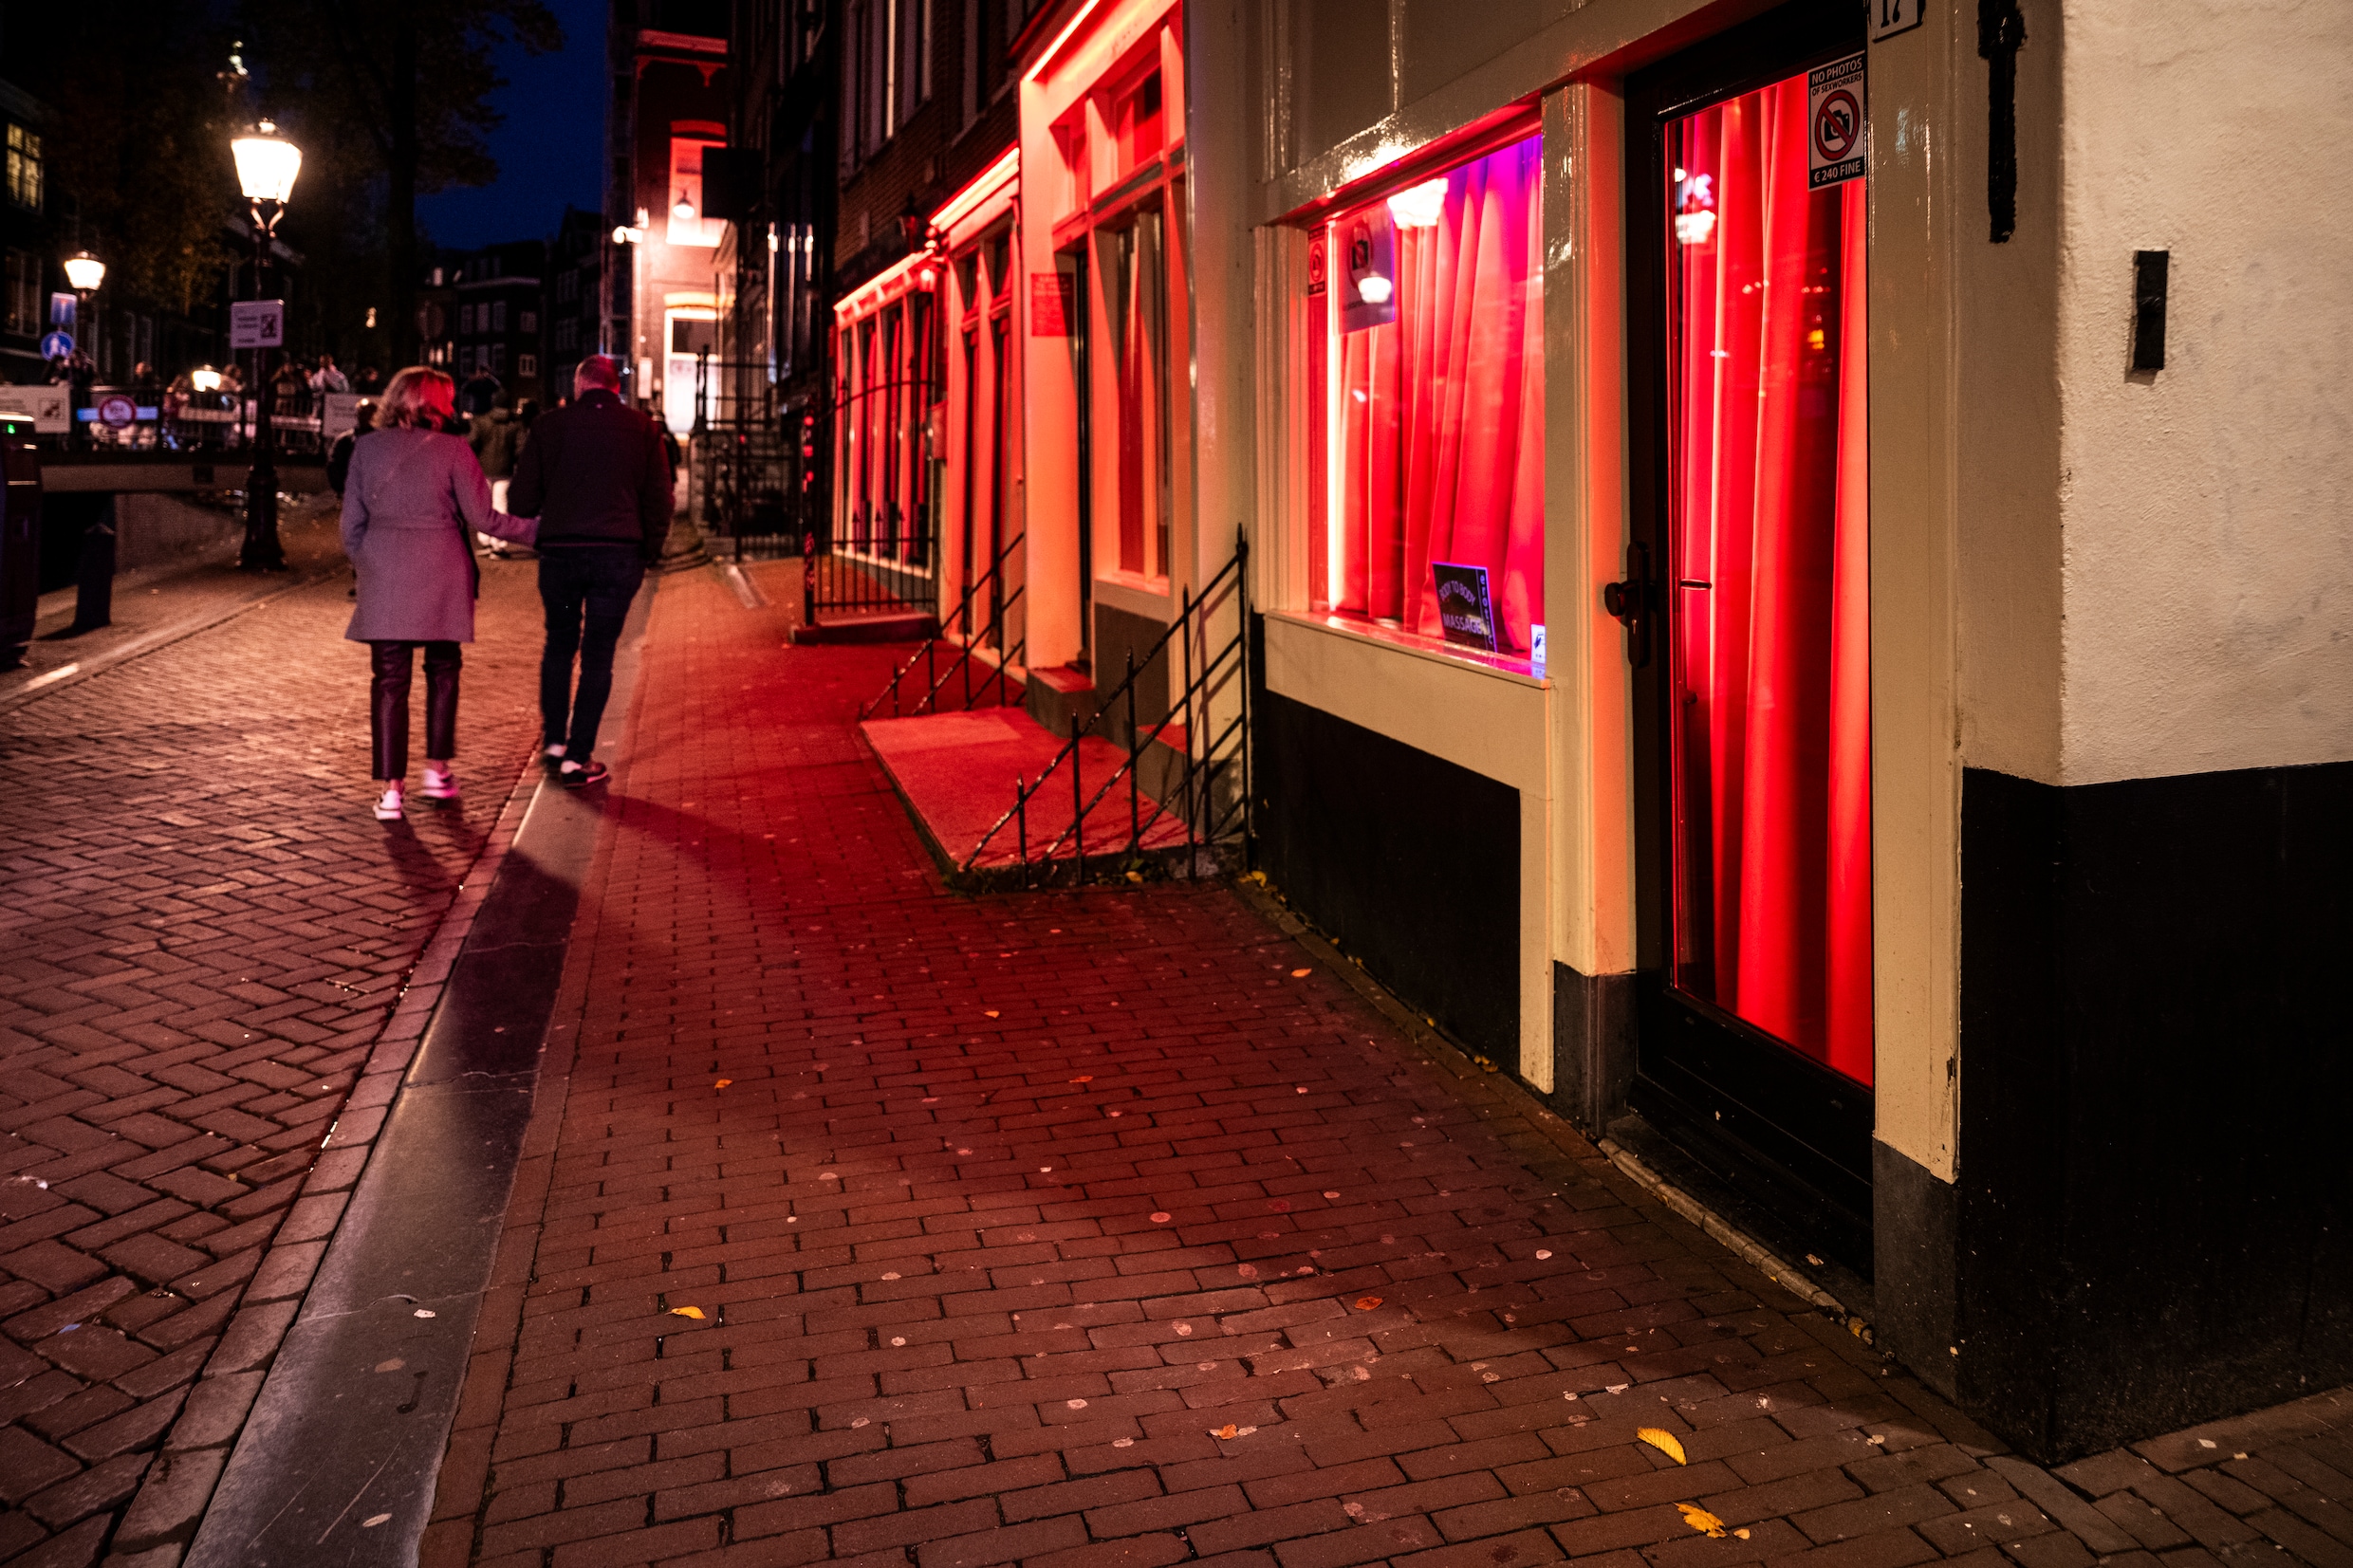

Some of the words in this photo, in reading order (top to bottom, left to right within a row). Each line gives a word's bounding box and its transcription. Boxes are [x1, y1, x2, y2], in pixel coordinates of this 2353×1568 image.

[1812, 71, 1825, 85] NO
[1826, 57, 1862, 80] PHOTOS
[1812, 86, 1821, 97] OF
[1822, 72, 1862, 93] SEXWORKERS
[1821, 166, 1839, 181] 240
[1840, 160, 1861, 176] FINE
[1439, 581, 1451, 601] BODY
[1452, 581, 1459, 593] TO
[1459, 583, 1475, 606] BODY
[1480, 575, 1492, 645] erotic
[1443, 614, 1482, 635] MASSAGE
